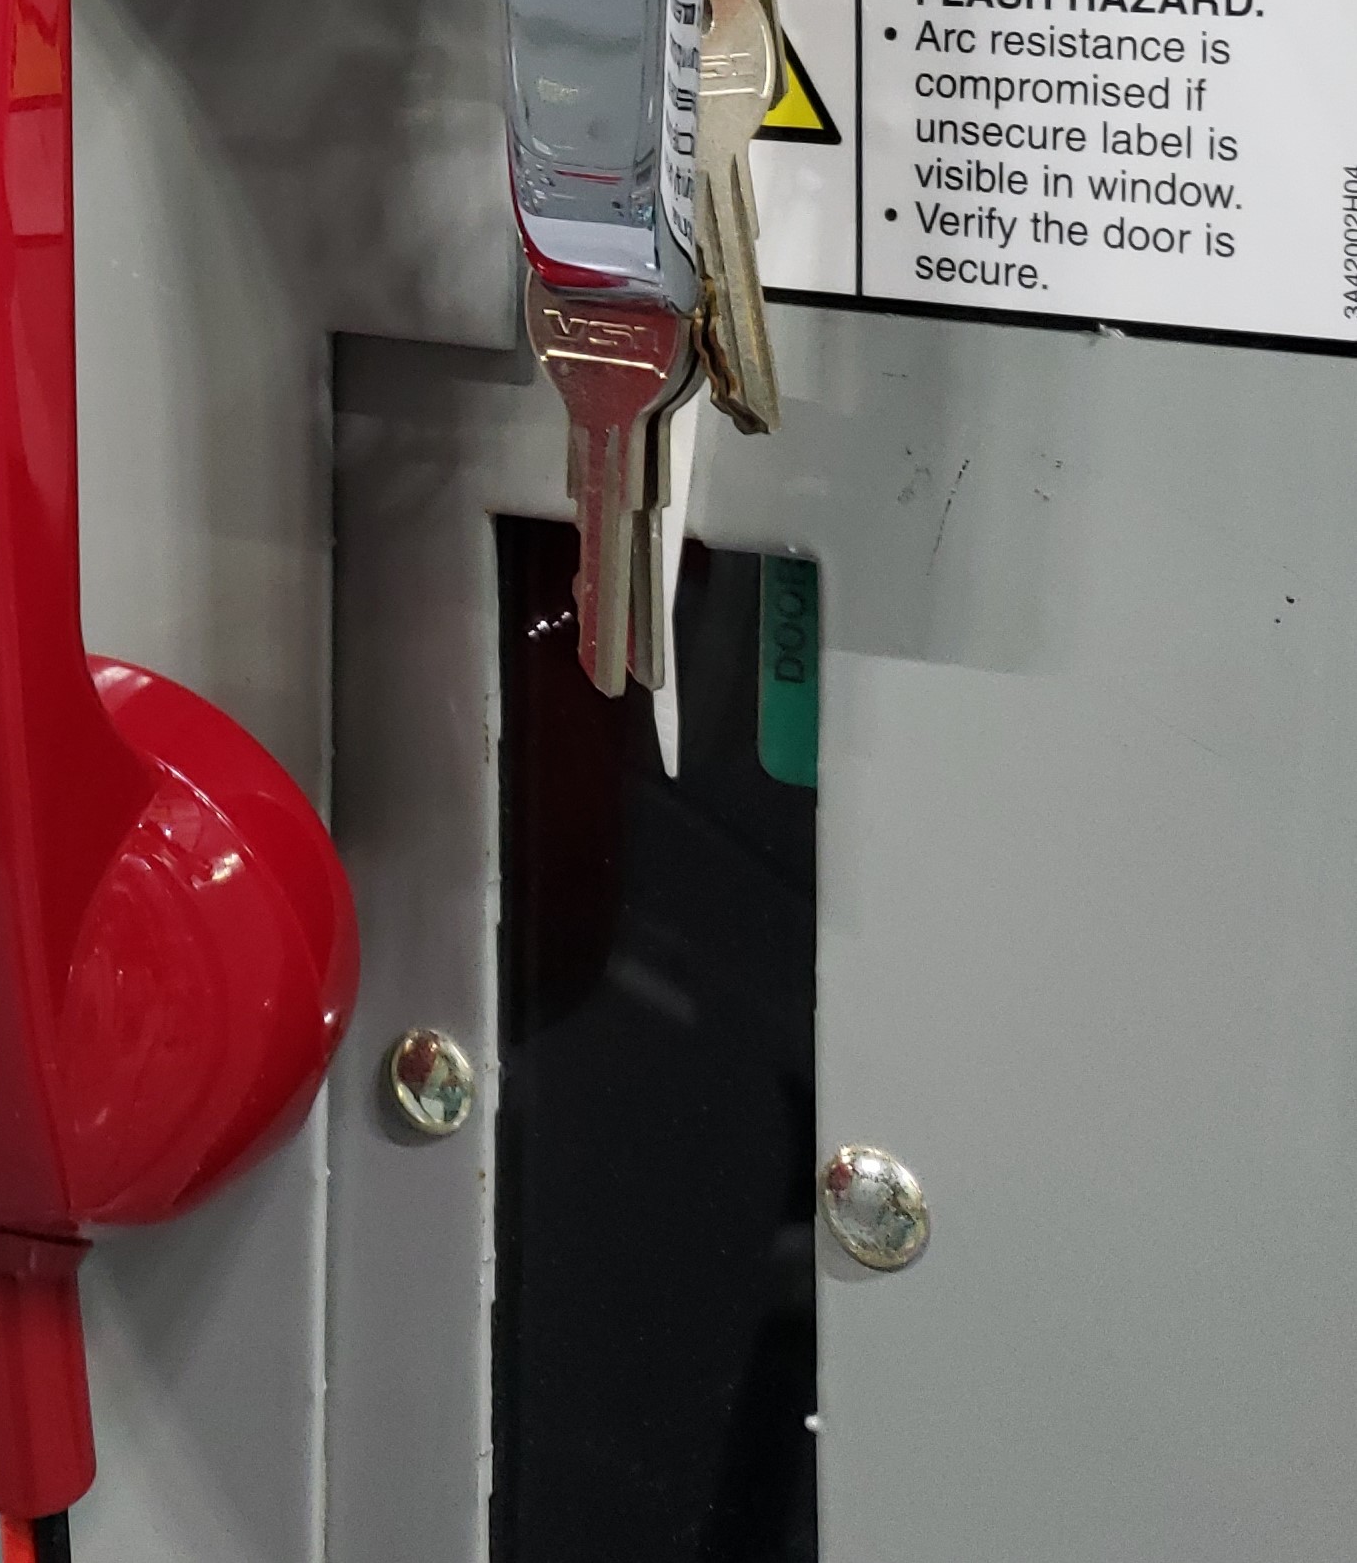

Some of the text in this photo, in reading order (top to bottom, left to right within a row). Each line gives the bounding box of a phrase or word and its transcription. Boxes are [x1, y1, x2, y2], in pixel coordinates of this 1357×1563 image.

[915, 20, 1231, 65] Arc resistance is
[915, 71, 1208, 111] compromised if
[915, 116, 1239, 162] unsecure label is
[914, 158, 1243, 210] visible in window.
[914, 201, 1236, 258] Verify the door is
[1342, 165, 1357, 320] 3A42002H04
[915, 253, 1049, 291] secure.
